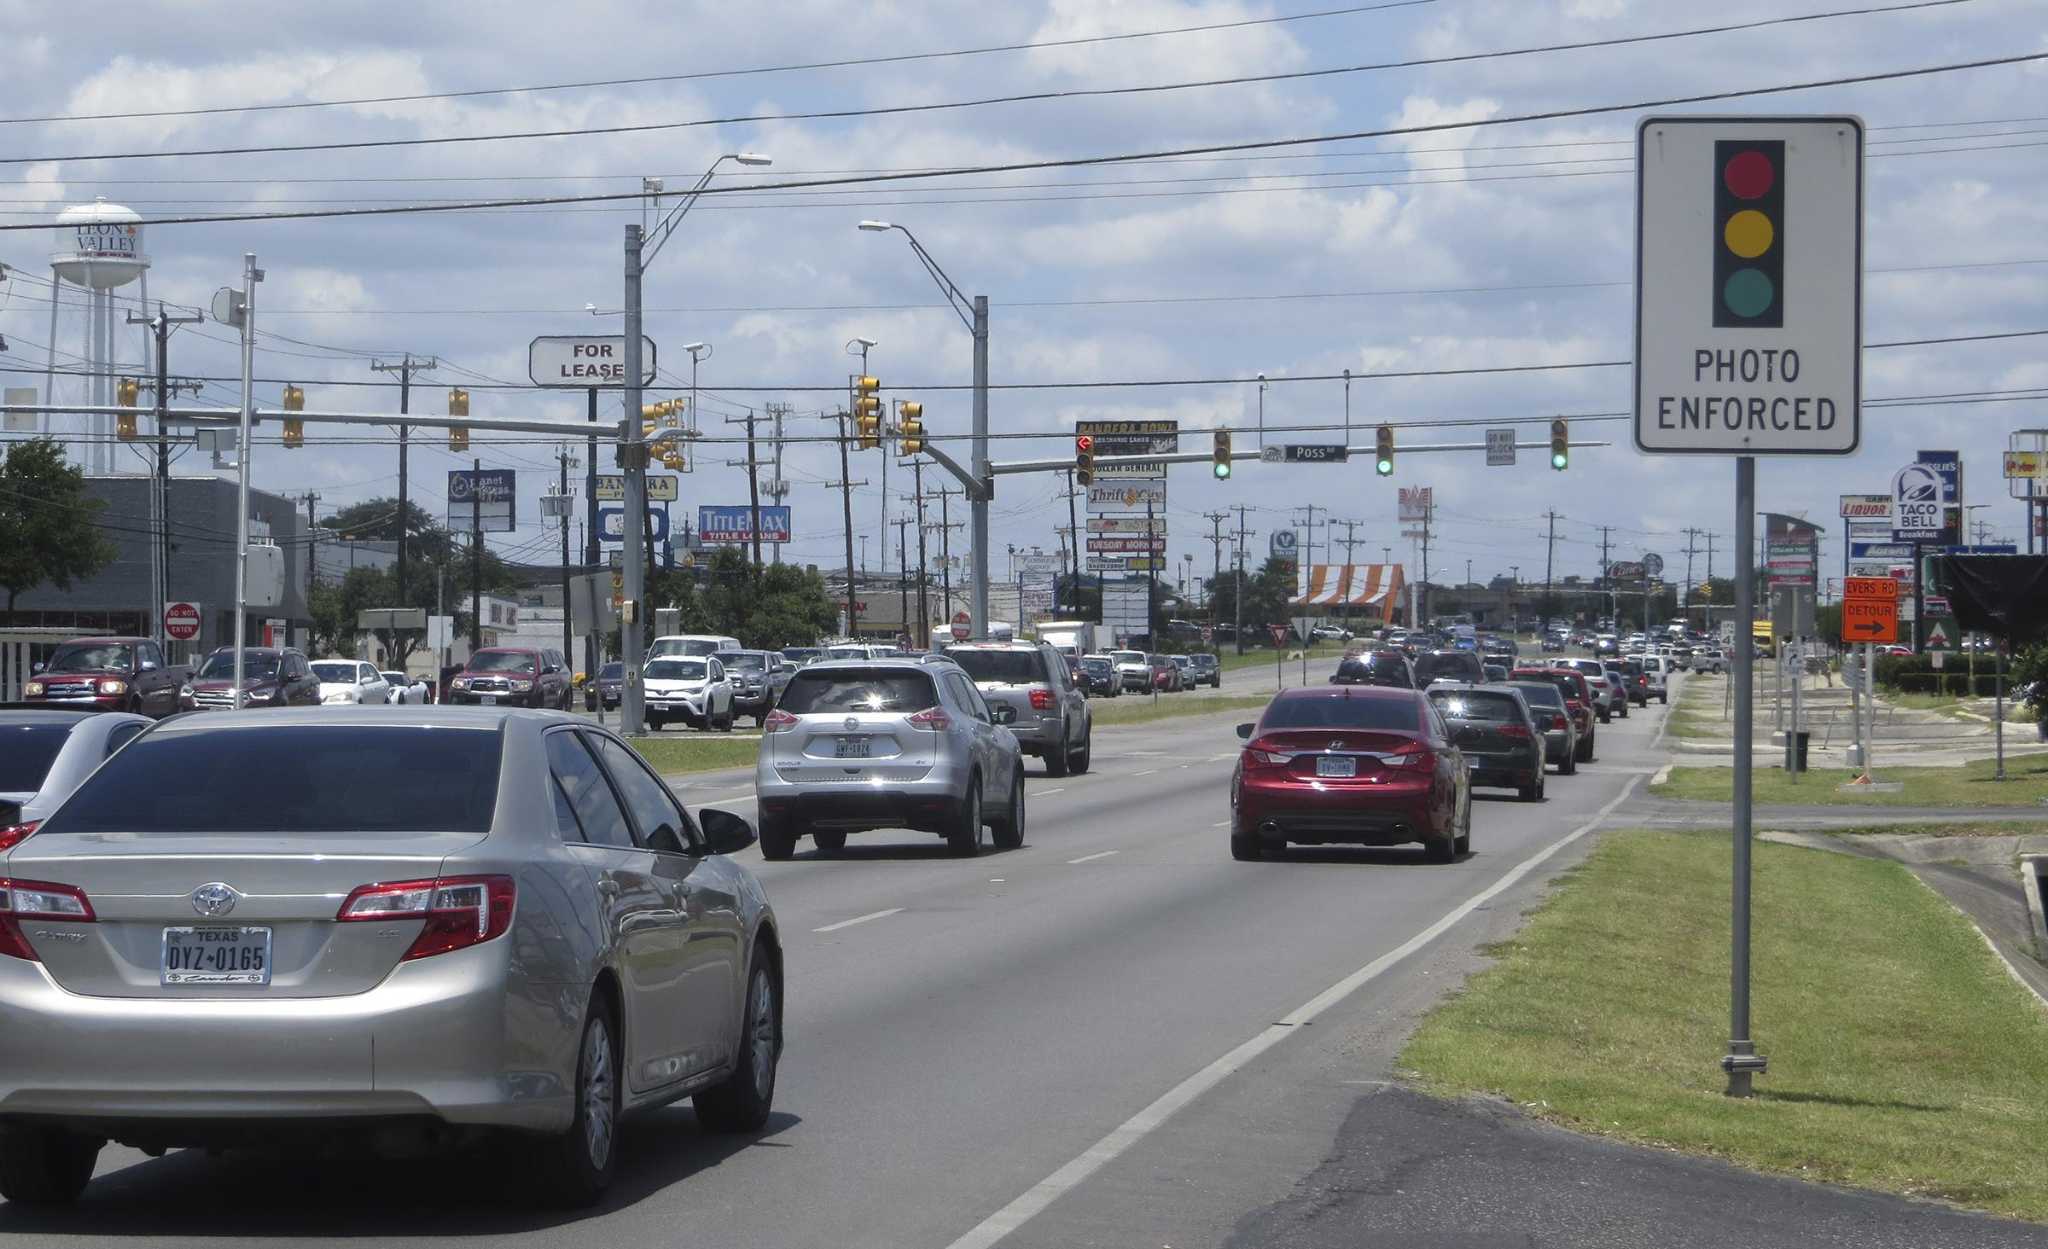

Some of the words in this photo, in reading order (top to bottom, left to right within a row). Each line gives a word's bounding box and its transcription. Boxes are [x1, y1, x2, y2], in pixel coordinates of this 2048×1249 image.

[77, 236, 136, 251] VALLEY
[573, 344, 612, 357] FOR
[561, 364, 624, 377] LEASE
[1695, 349, 1800, 383] PHOTO
[1657, 397, 1836, 431] ENFORCED
[597, 479, 669, 489] BANRA
[1843, 504, 1886, 515] LIQUOR
[1899, 504, 1937, 515] TACO
[1902, 516, 1936, 527] BELL
[708, 532, 738, 540] TITLE
[1846, 582, 1875, 594] EVERS
[1881, 582, 1895, 594] RD
[1847, 605, 1892, 617] DETOUR
[198, 931, 239, 942] TEXAS
[169, 946, 204, 970] DYZ
[215, 946, 263, 971] 0165
